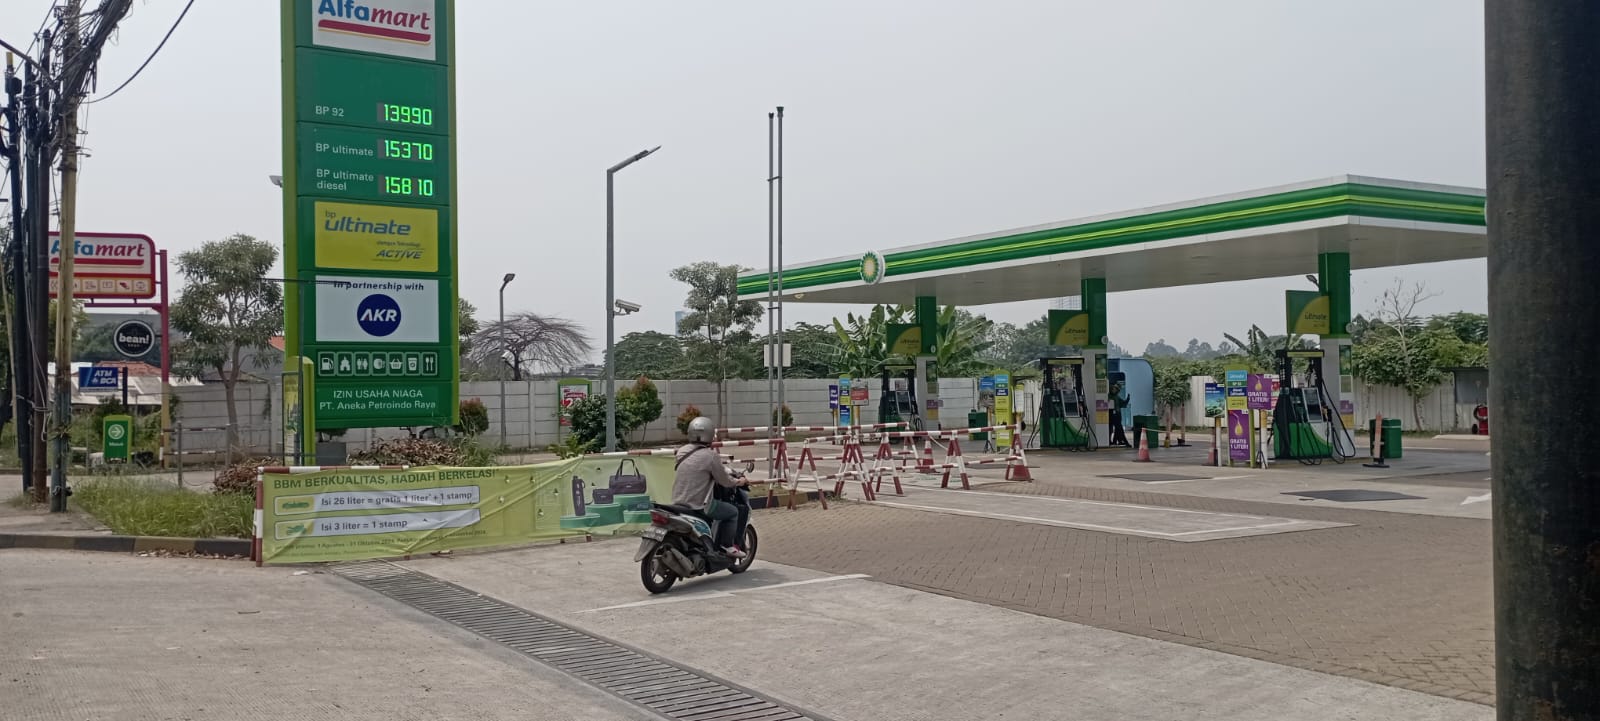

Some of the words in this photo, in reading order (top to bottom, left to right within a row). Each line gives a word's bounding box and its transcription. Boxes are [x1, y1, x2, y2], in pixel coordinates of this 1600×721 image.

[317, 0, 431, 30] Alfamart
[315, 105, 330, 116] BP
[331, 107, 344, 117] 92
[383, 104, 433, 126] 13990
[315, 143, 330, 153] BP
[332, 143, 374, 157] ultimate
[384, 139, 433, 161] 15370
[316, 168, 331, 179] BP
[333, 169, 374, 182] ultimate
[316, 179, 347, 191] diesel
[325, 210, 336, 219] bp
[324, 216, 411, 236] ultimate
[50, 239, 145, 257] Afamart
[375, 249, 424, 260] ACTIVE
[345, 281, 403, 292] partnership
[404, 282, 425, 291] with
[360, 308, 398, 322] AKR
[118, 332, 150, 344] bean!
[94, 369, 113, 377] ATM
[100, 377, 116, 385] BCA
[333, 390, 353, 399] IZIN
[355, 389, 390, 399] USAHA
[392, 389, 423, 398] NIAGA
[319, 402, 335, 410] PT.
[337, 401, 366, 410] Aneka
[368, 401, 412, 409] Petroindo
[414, 400, 436, 410] Raya
[274, 479, 301, 489] BBM
[304, 475, 388, 488] BERKUALITAS,
[391, 472, 435, 484] HADIAH
[321, 498, 332, 506] Isi
[347, 495, 365, 505] liter
[446, 492, 473, 501] stamp
[321, 523, 332, 532] Isi
[334, 522, 340, 531] 3
[342, 520, 361, 530] liter
[379, 519, 408, 530] stamp
